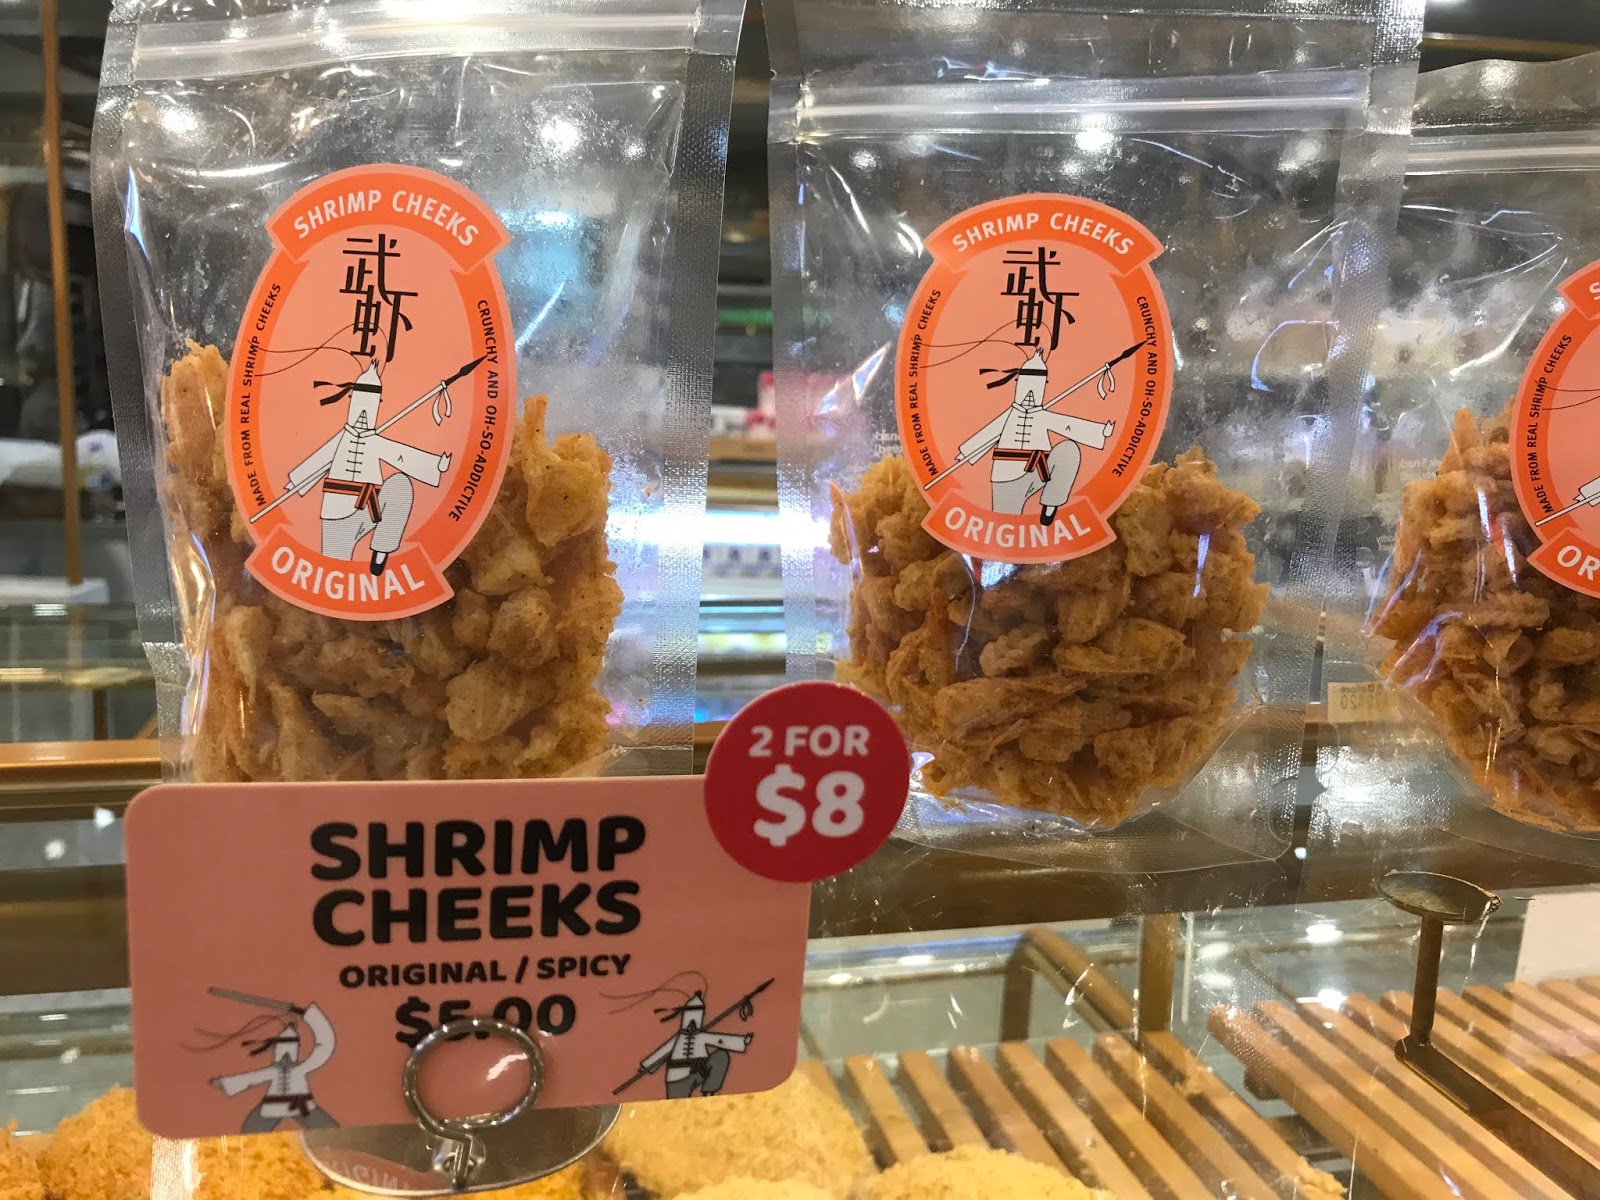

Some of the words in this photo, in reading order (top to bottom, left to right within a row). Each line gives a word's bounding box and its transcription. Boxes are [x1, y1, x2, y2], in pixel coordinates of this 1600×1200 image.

[293, 190, 382, 239] SHRIMP
[391, 190, 479, 246] CHEEKS
[952, 213, 1039, 253] SHRIMP
[1049, 212, 1134, 255] CHEEKS
[255, 283, 281, 331] CHEEKS
[339, 233, 418, 363] 武虾
[917, 289, 942, 330] CHEEKS
[1001, 246, 1079, 350] 武虾
[477, 300, 498, 365] CRUNCHY
[1136, 296, 1158, 348] CRUNCHY
[243, 335, 260, 387] SHRIMP
[908, 333, 924, 378] SHRIMP
[1146, 351, 1158, 376] AND
[1543, 334, 1572, 373] CHEEKS
[486, 369, 499, 399] AND
[908, 382, 919, 410] REAL
[1529, 376, 1549, 418] SHRIMP
[240, 392, 251, 424] REAL
[911, 412, 926, 444] FROM
[1111, 379, 1157, 477] OH-SO-ADDICTIVE
[240, 429, 253, 467] FROM
[1526, 422, 1539, 448] REAL
[448, 405, 498, 522] OH-SO-ADDICTIVE
[918, 446, 939, 476] MADE
[1527, 451, 1542, 481] FROM
[247, 469, 267, 506] MADE
[1533, 484, 1555, 514] MADE
[943, 506, 1091, 548] ORIGINAL
[271, 546, 426, 602] ORIGINAL
[748, 724, 774, 758] 2
[784, 724, 871, 758] FOR
[753, 762, 865, 848] $8
[310, 815, 647, 881] SHRIMP
[312, 879, 642, 947] CHEEKS
[338, 959, 507, 989] ORIGINAL
[514, 954, 530, 985] /
[536, 953, 632, 980] SPICY
